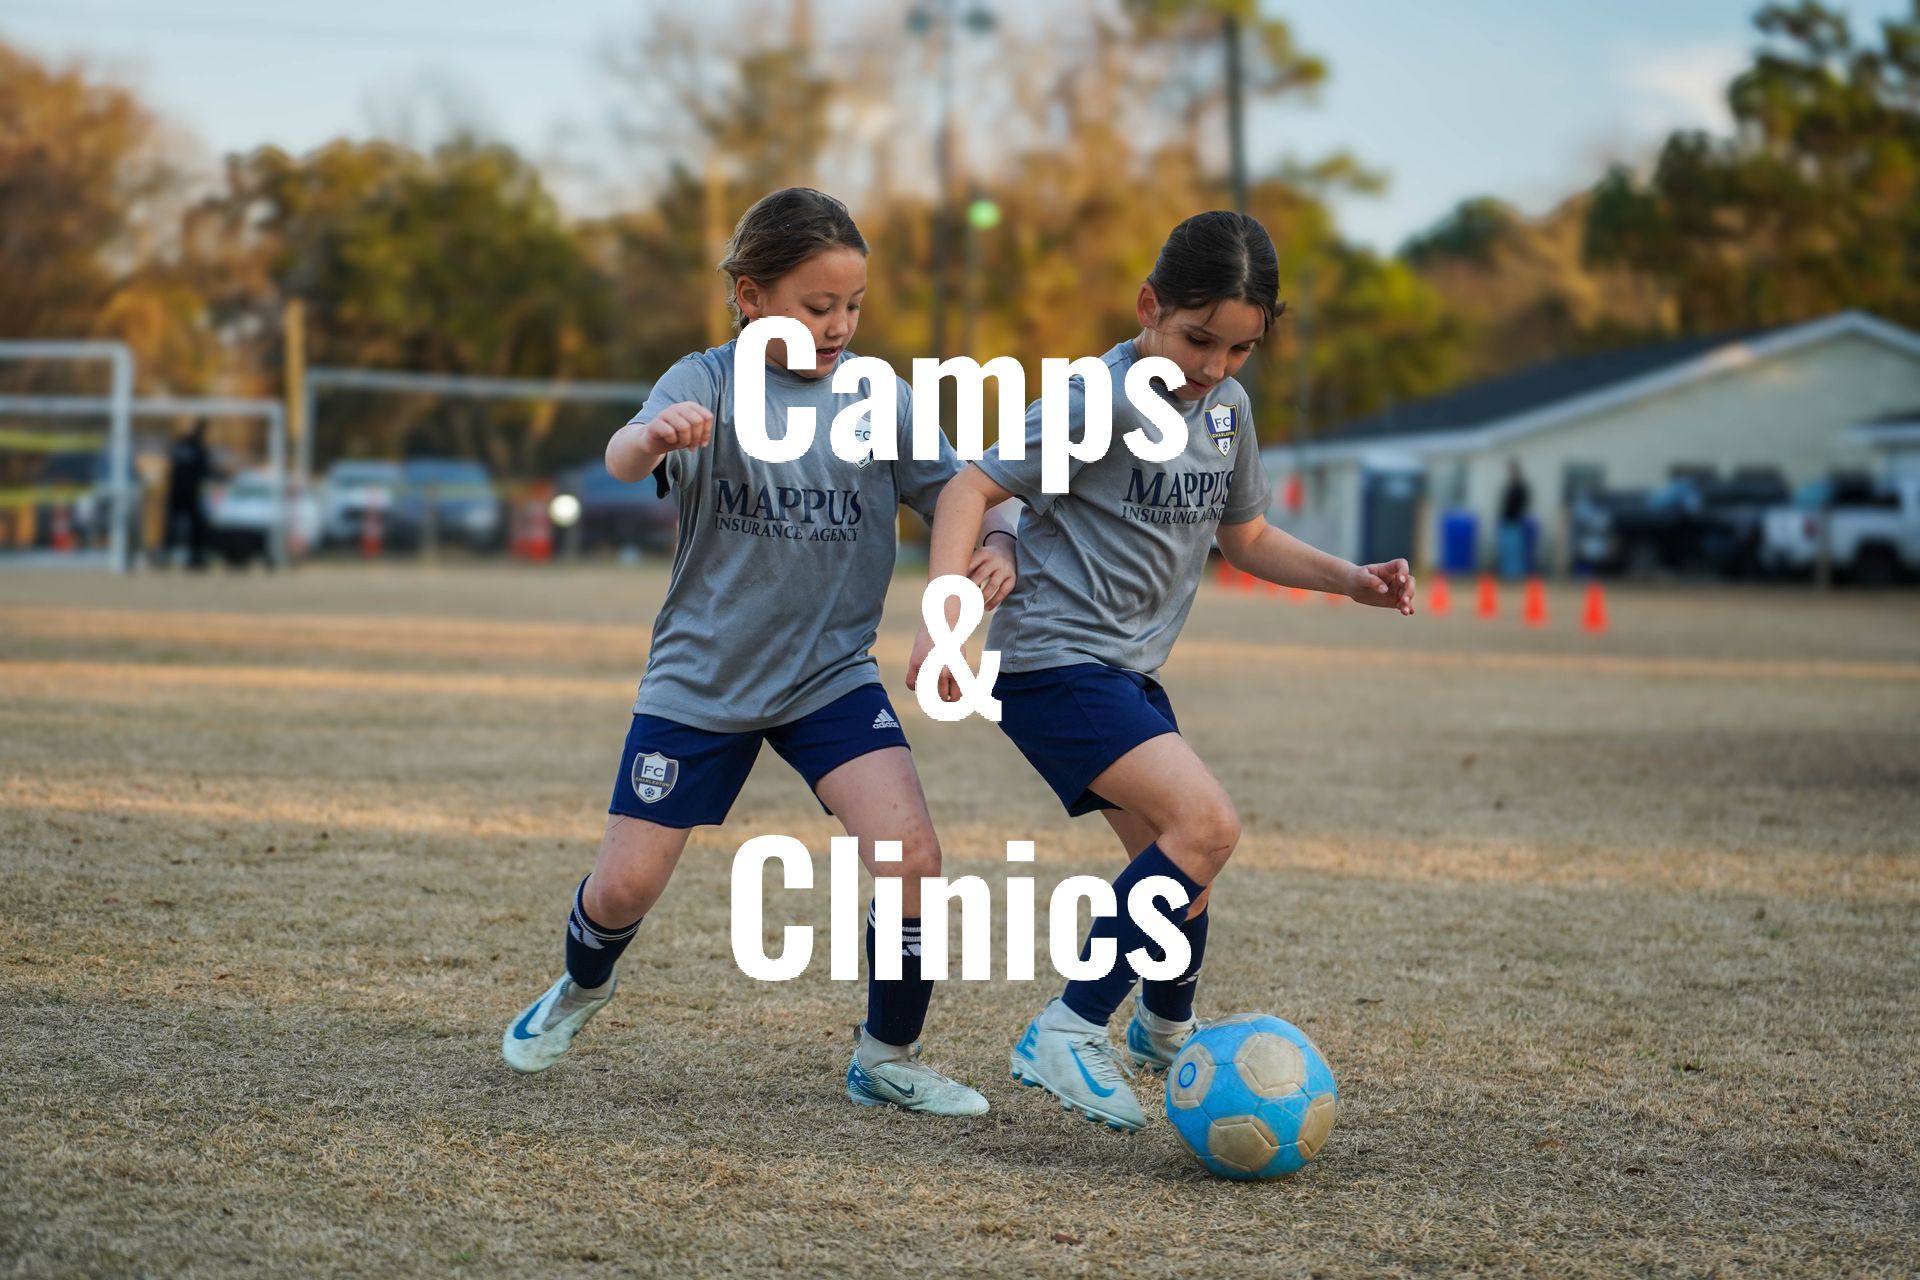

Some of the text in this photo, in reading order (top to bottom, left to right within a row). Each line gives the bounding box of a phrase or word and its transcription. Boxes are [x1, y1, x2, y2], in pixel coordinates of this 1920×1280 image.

[1214, 416, 1232, 429] FC
[716, 479, 862, 526] MAPPUS
[1122, 504, 1199, 525] INSURANCE
[715, 515, 803, 540] INSURANCE
[643, 765, 665, 777] FC
